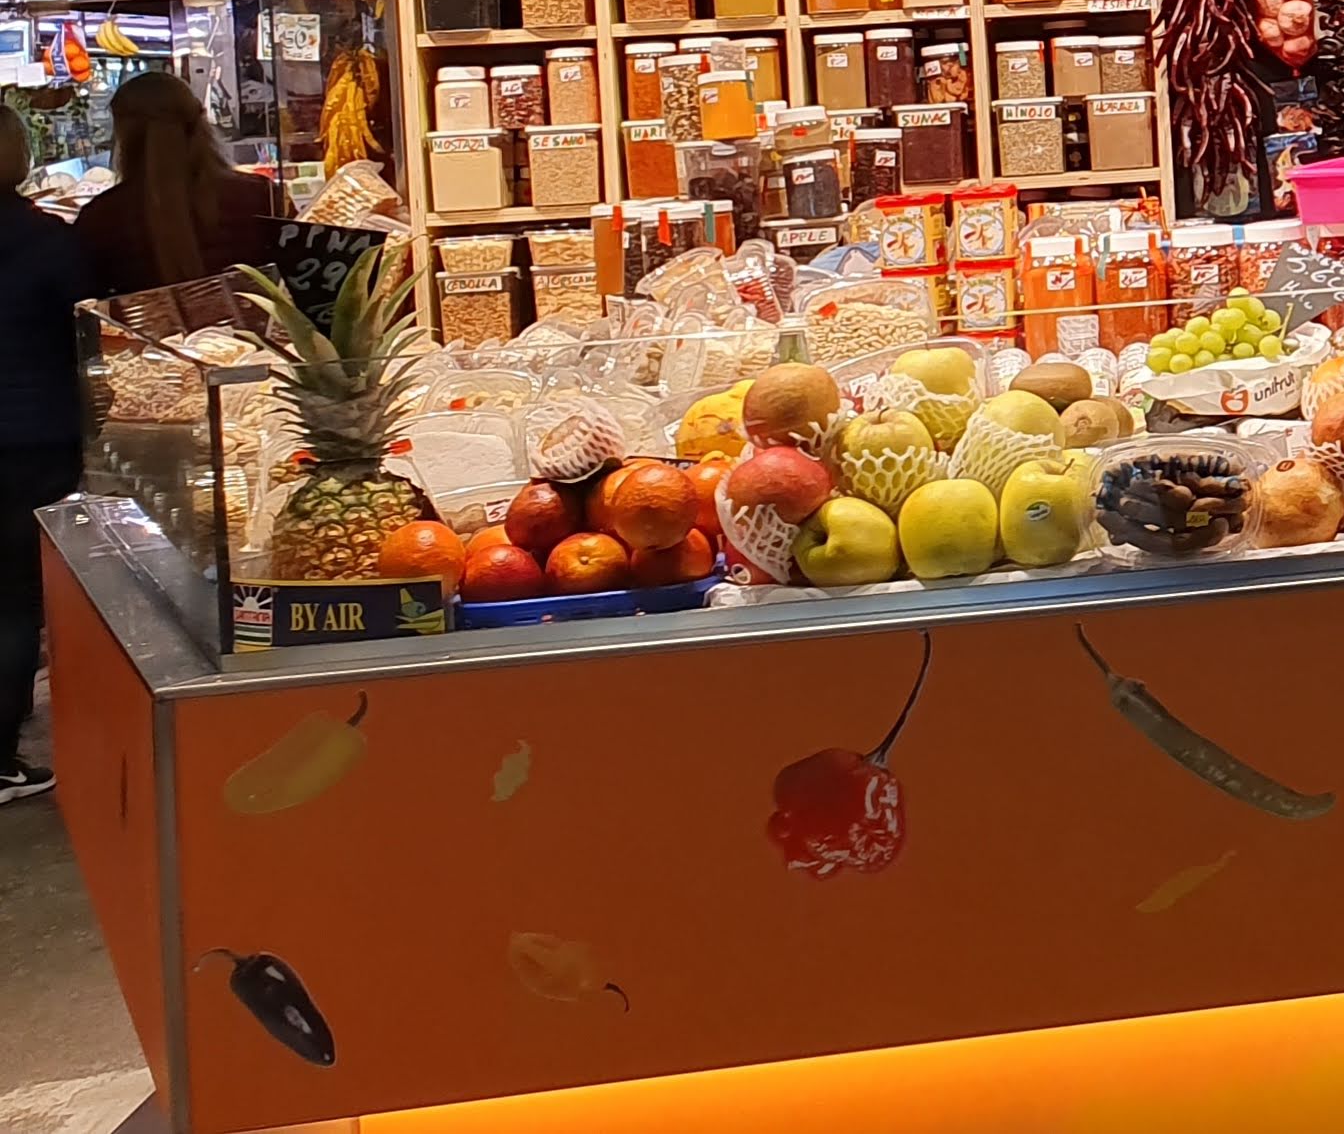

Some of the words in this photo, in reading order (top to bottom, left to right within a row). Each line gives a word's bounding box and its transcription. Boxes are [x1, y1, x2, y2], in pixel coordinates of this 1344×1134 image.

[901, 113, 948, 126] SUMAC
[433, 137, 486, 152] MOSTAZA
[780, 231, 828, 245] APPLE
[446, 277, 498, 292] CEBOLLA
[290, 602, 320, 631] BY
[323, 602, 366, 631] AIR
